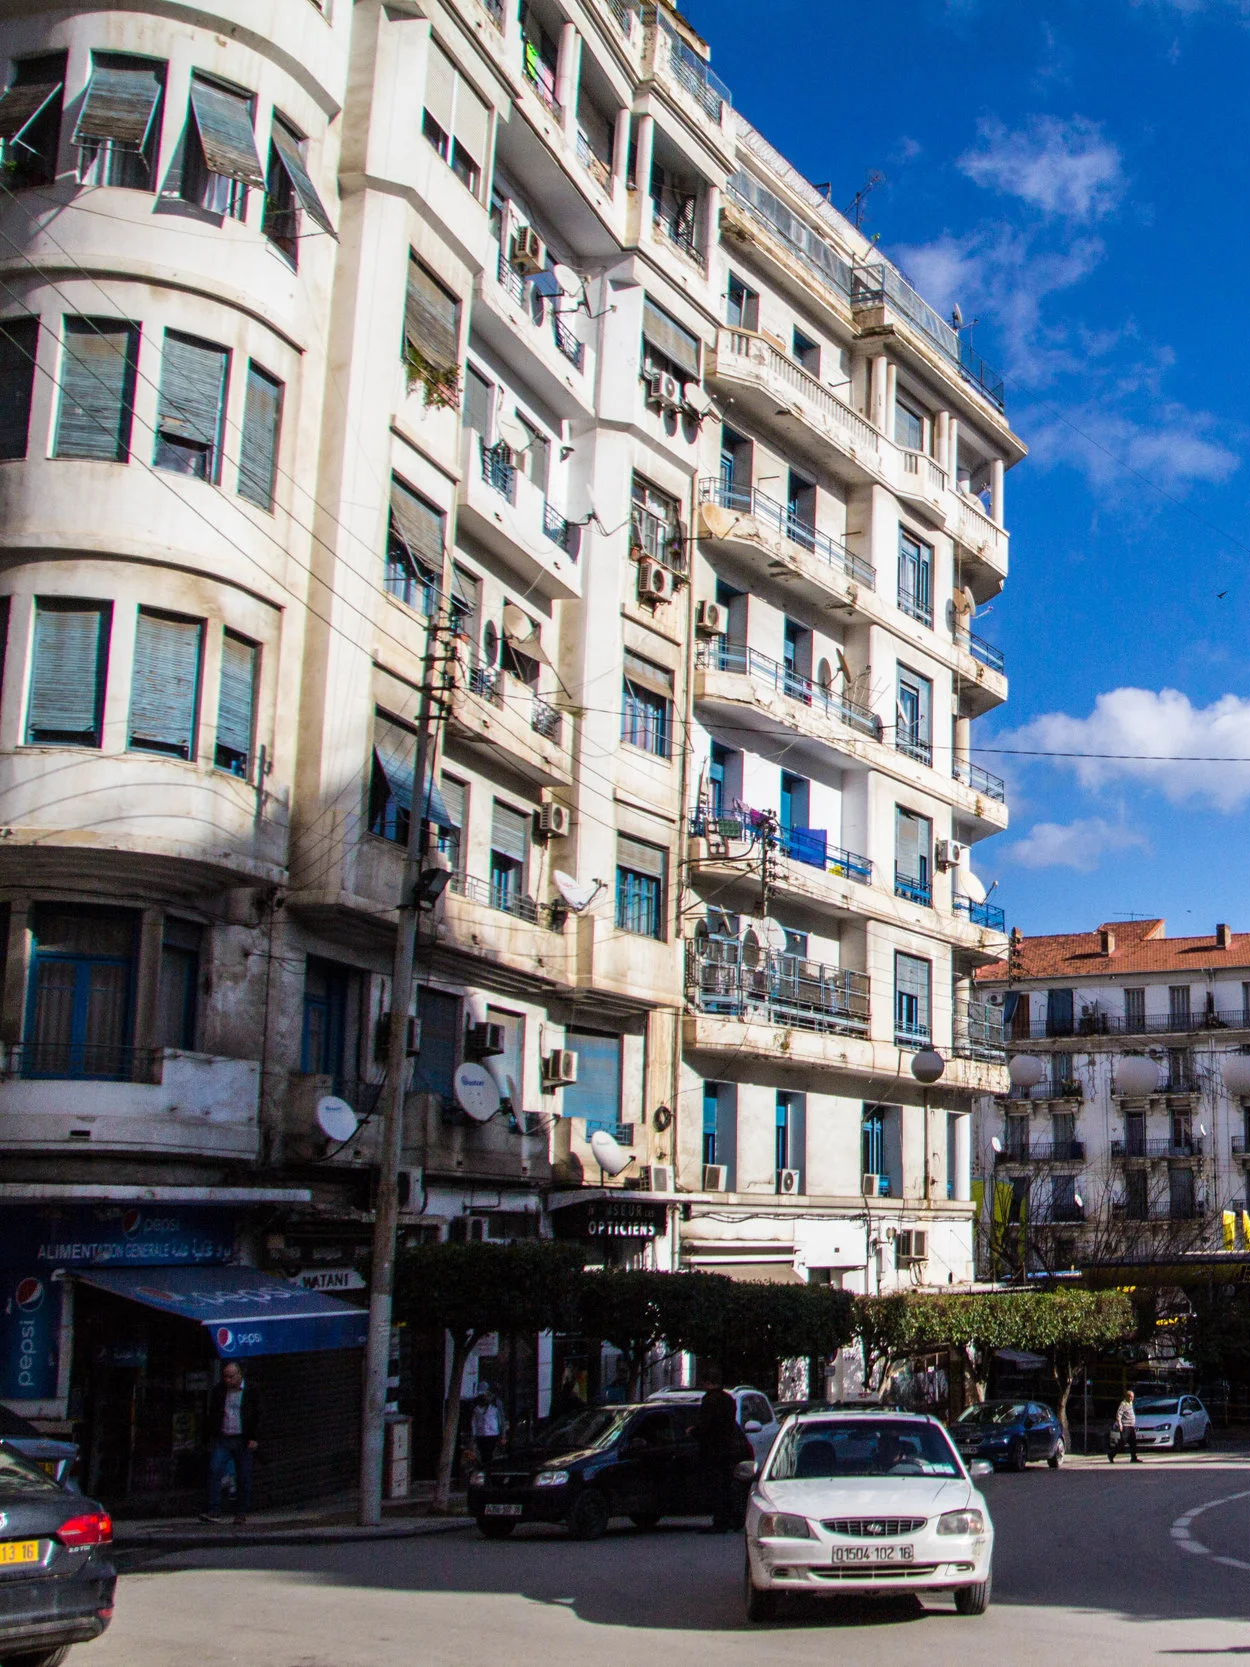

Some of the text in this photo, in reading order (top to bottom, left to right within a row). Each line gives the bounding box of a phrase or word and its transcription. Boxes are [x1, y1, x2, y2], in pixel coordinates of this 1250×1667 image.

[588, 1220, 656, 1236] OPTICIENS
[302, 1272, 350, 1289] WATANI
[237, 1332, 261, 1346] pepsi
[18, 1319, 36, 1387] pepsi
[22, 1543, 34, 1559] 16
[836, 1547, 870, 1561] 01504
[874, 1546, 894, 1560] 102
